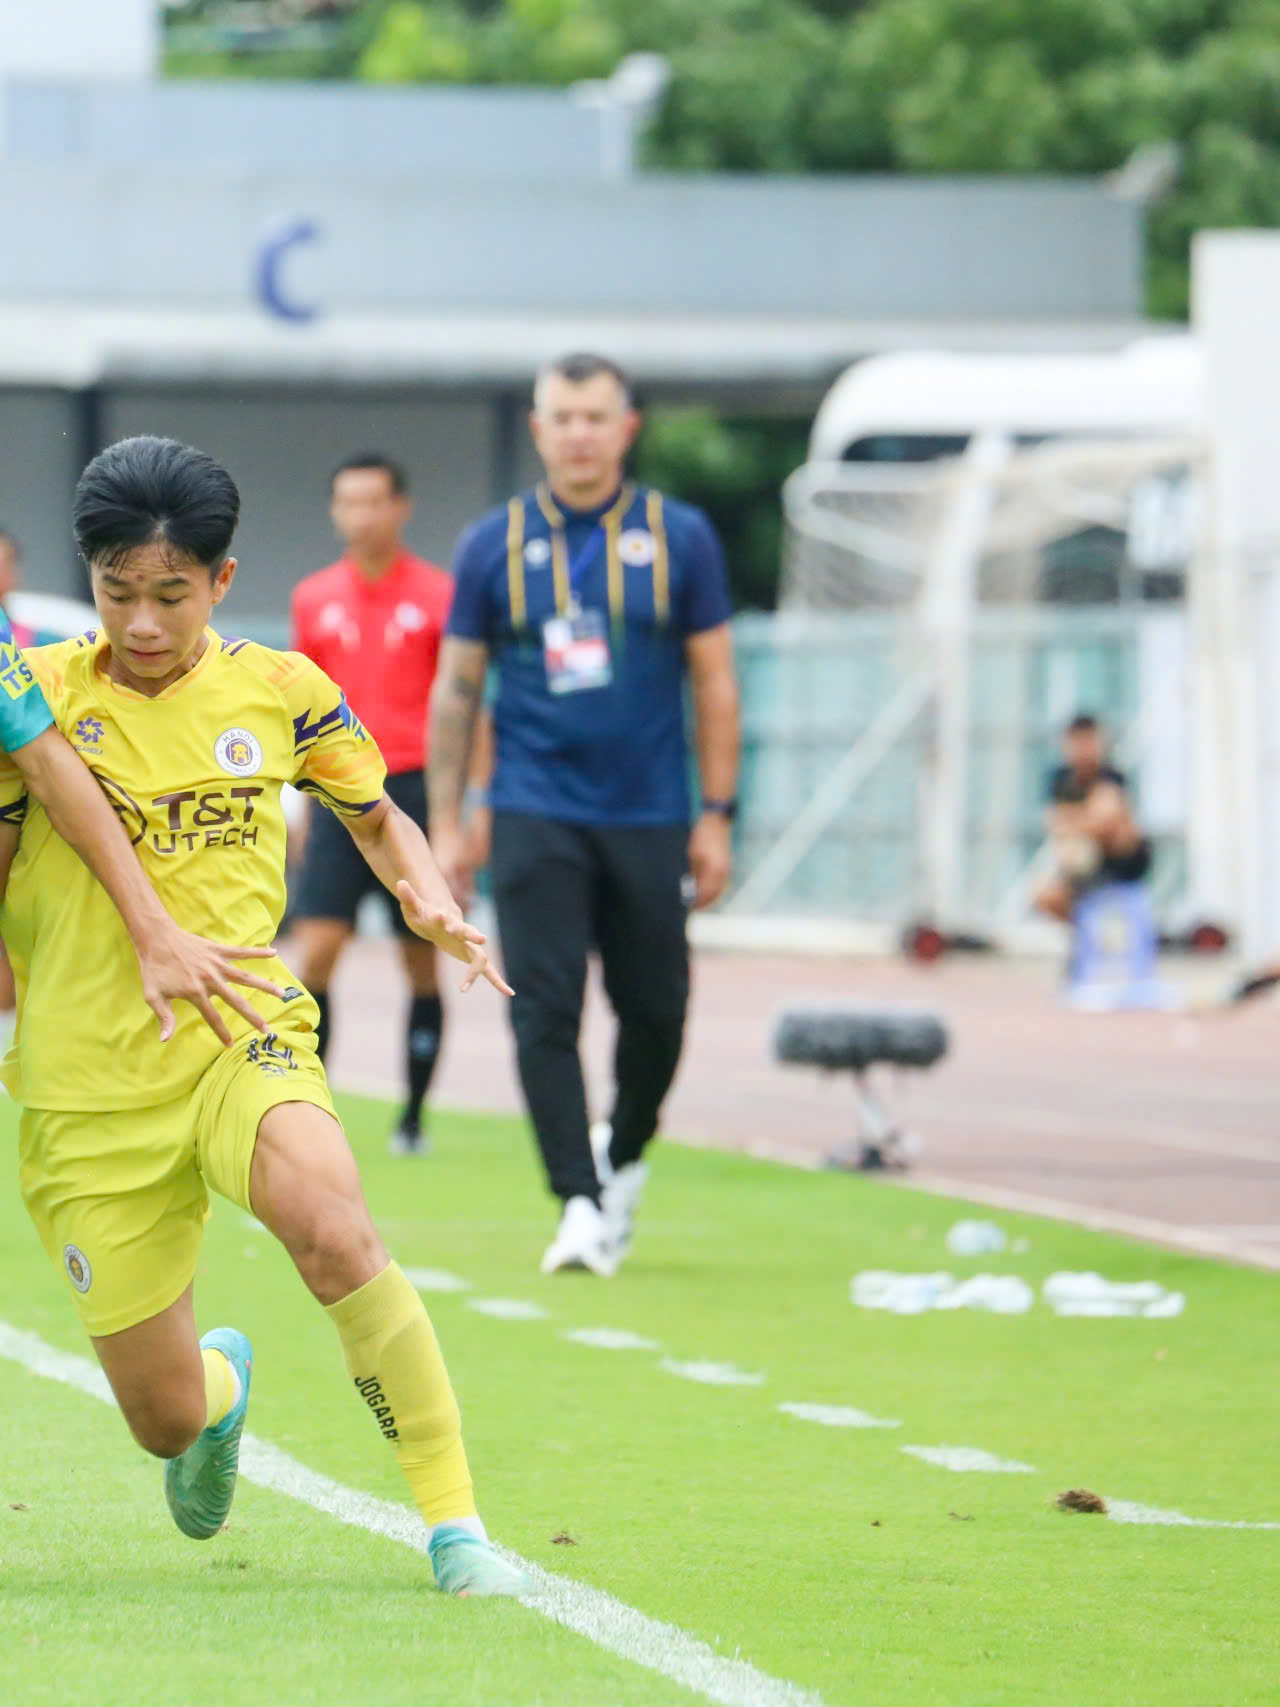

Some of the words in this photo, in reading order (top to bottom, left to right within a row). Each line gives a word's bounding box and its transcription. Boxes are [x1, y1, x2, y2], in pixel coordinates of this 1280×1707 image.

[253, 219, 321, 325] C
[152, 786, 264, 831] T&T
[153, 826, 259, 853] UTECH
[354, 1376, 400, 1443] JOGARB
